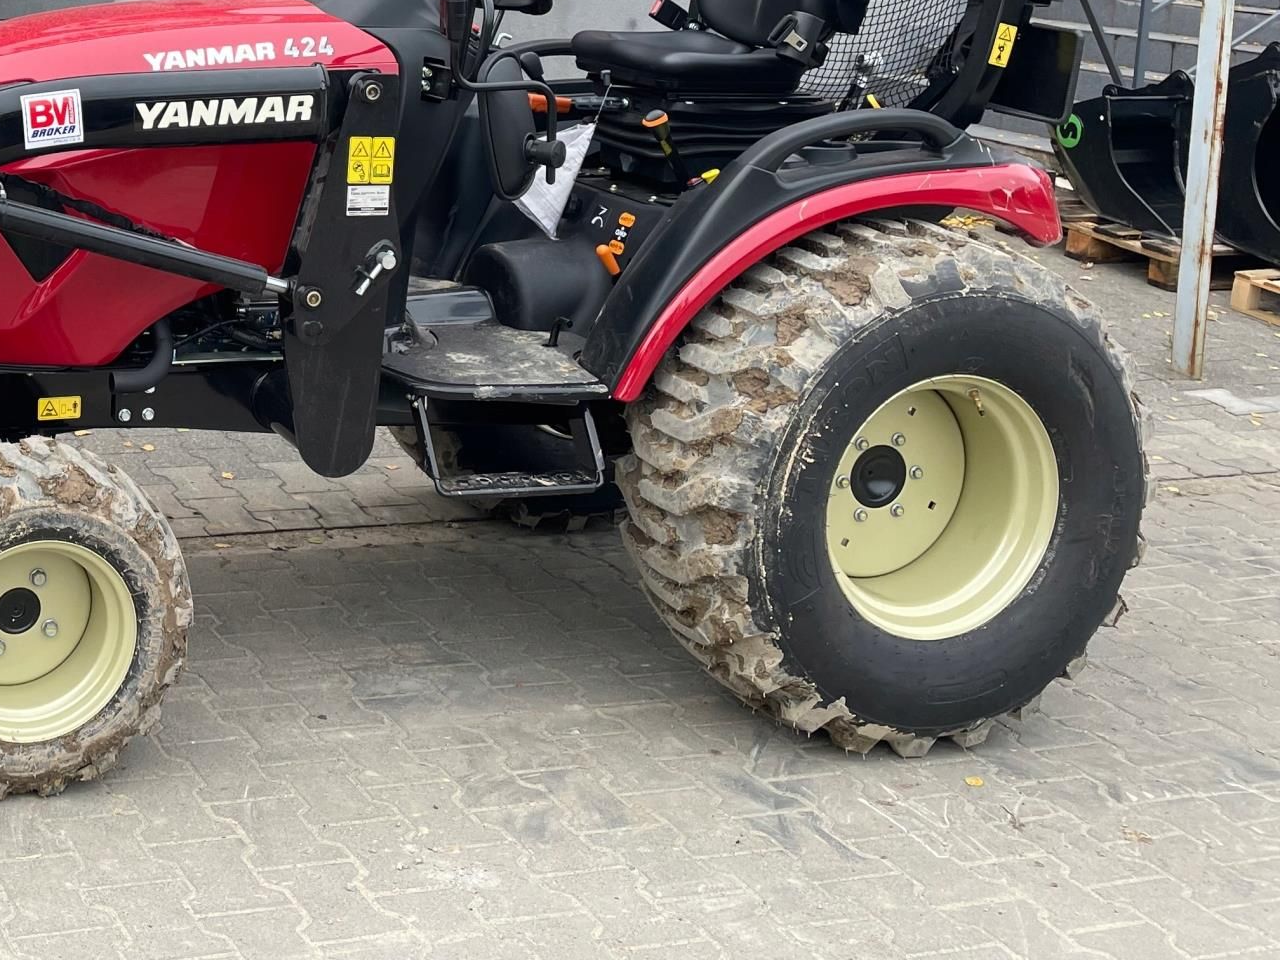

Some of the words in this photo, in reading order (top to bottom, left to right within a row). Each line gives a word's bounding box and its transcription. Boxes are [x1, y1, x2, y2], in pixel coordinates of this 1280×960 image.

[143, 41, 277, 72] YANMAR
[283, 36, 335, 58] 424
[135, 94, 315, 130] YANMAR
[31, 125, 76, 138] BROKER
